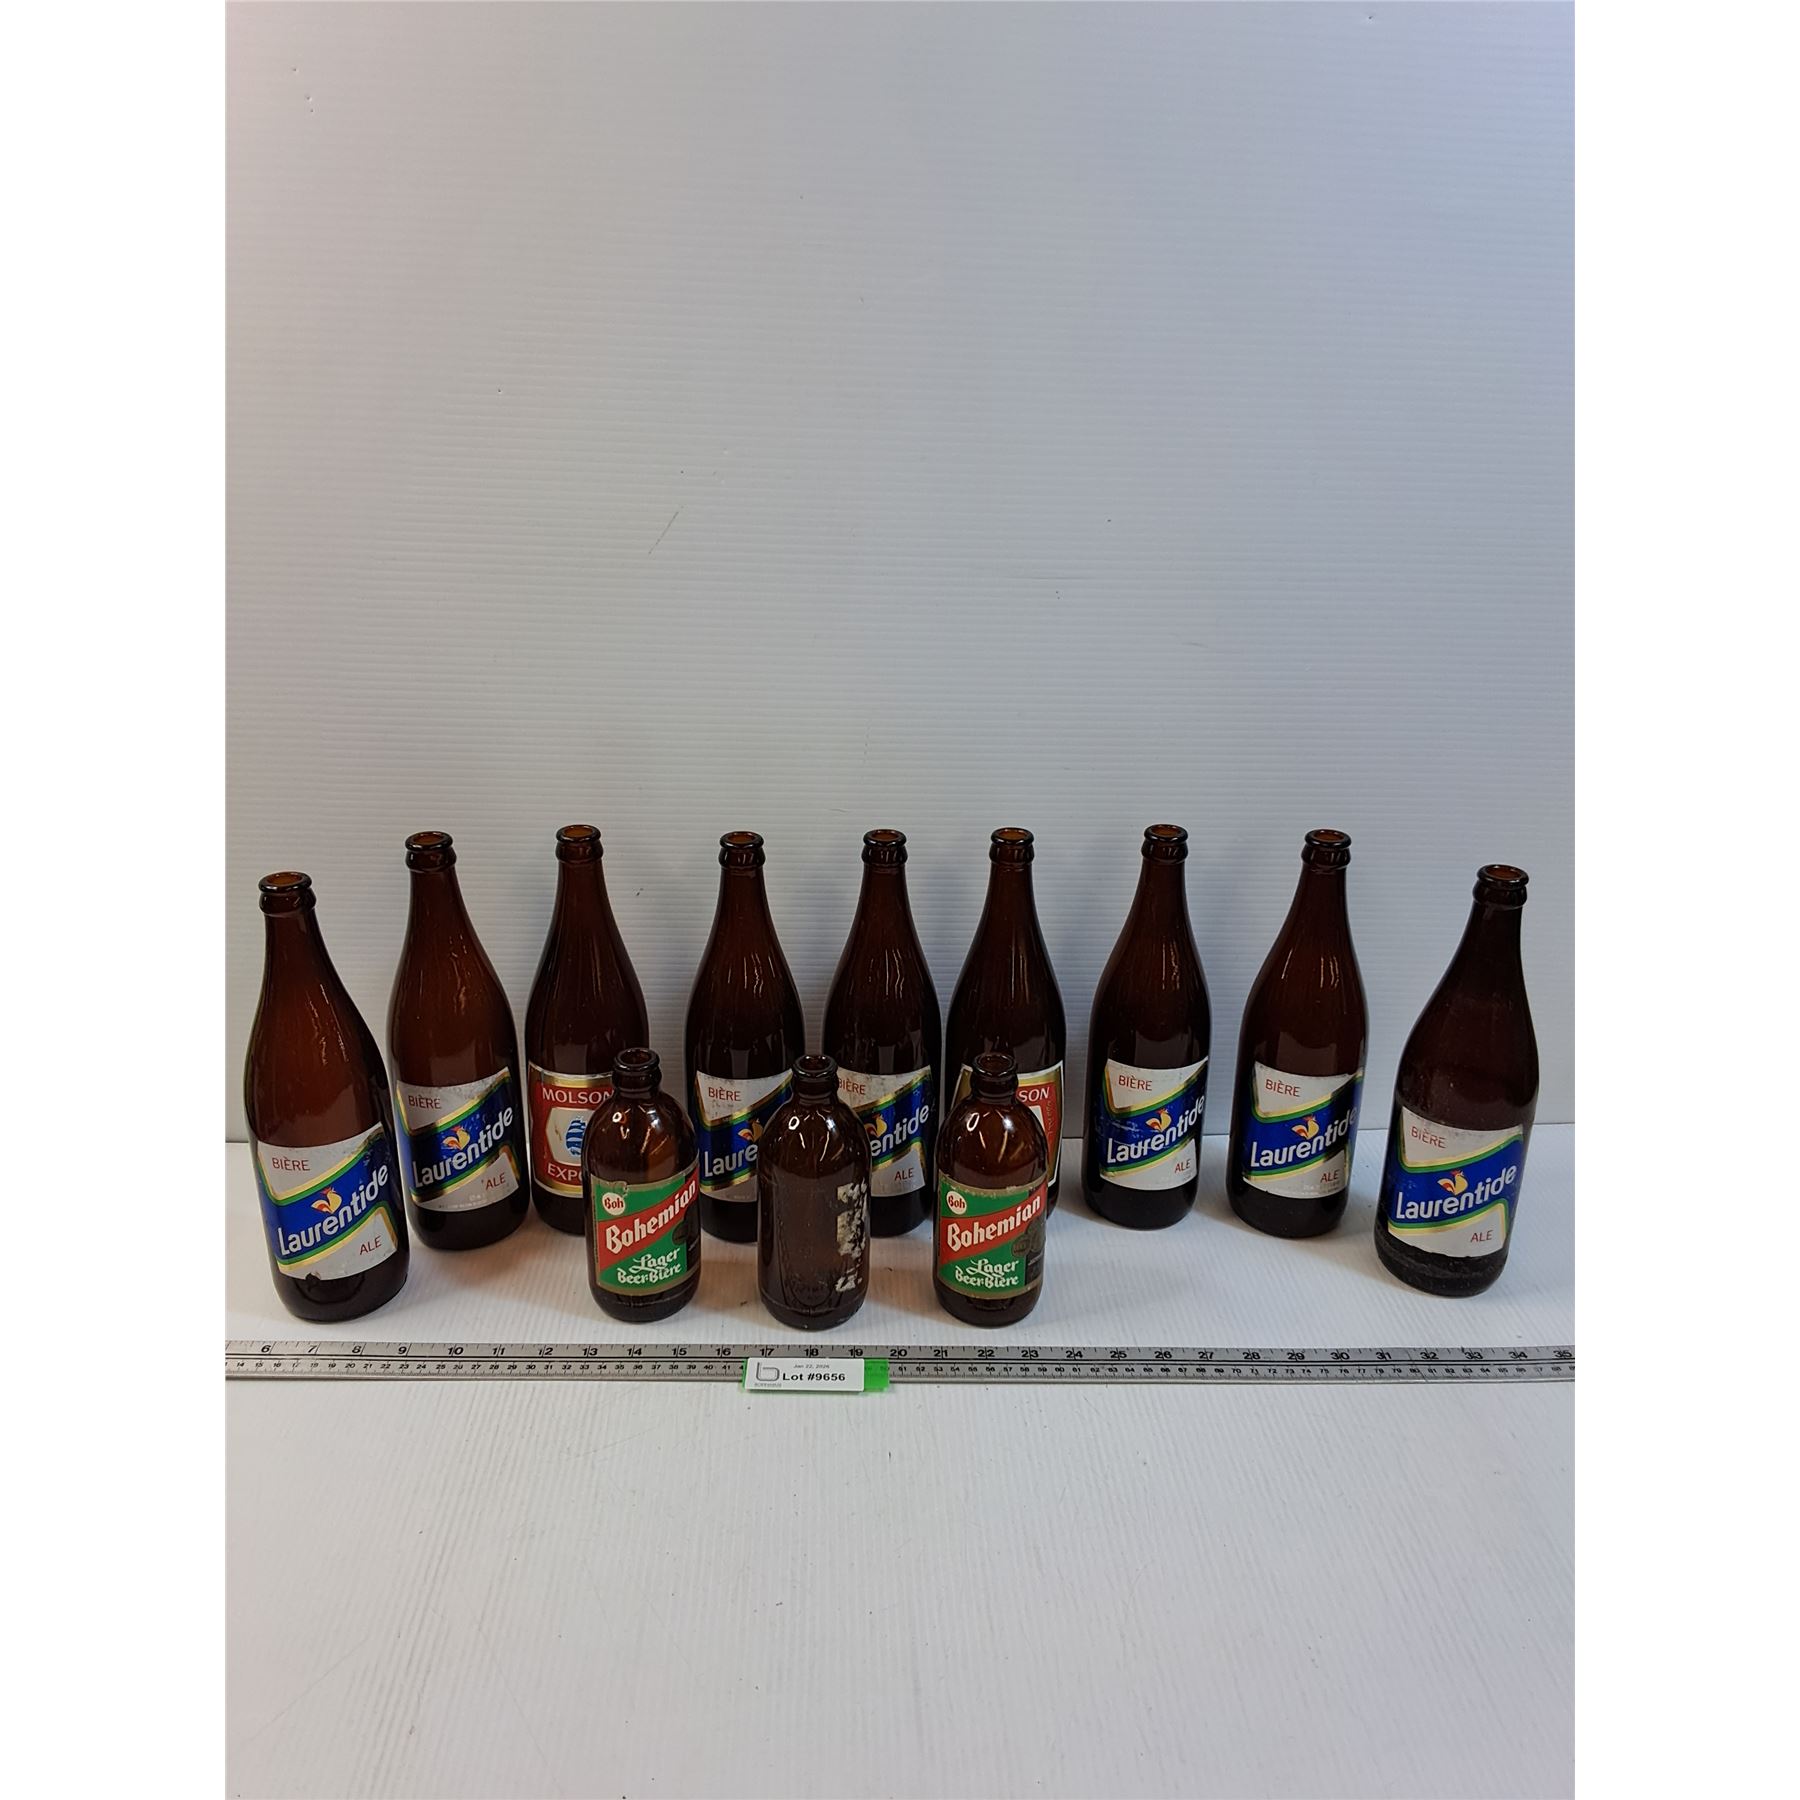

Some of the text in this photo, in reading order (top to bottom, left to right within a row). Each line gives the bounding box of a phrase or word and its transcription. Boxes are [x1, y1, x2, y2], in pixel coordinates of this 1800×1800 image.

[1118, 1074, 1152, 1091] BIÈRE
[1265, 1079, 1300, 1097] BIÈRE
[408, 1095, 442, 1110] BIÈRE
[709, 1087, 741, 1101] BIÈRE
[1018, 1086, 1050, 1102] SON
[871, 1104, 929, 1157] entide
[1107, 1096, 1205, 1163] Laurentide
[1250, 1106, 1357, 1167] Laurentide
[1411, 1126, 1446, 1148] BIÈRE
[413, 1106, 514, 1188] Laurentide
[272, 1157, 310, 1171] BIÈRE
[704, 1143, 758, 1177] Laure
[1174, 1160, 1191, 1173] ALE
[548, 1163, 582, 1181] EXP
[894, 1168, 914, 1181] ALE
[1320, 1169, 1339, 1183] ALE
[486, 1172, 506, 1191] ALE
[1396, 1165, 1517, 1219] Laurentide
[277, 1164, 389, 1256] Laurentide
[604, 1198, 623, 1209] Boh
[948, 1196, 965, 1208] Boh
[606, 1181, 695, 1254] Bohemian
[947, 1196, 1040, 1252] Bohemian
[1470, 1230, 1493, 1243] ALE
[359, 1236, 382, 1256] ALE
[629, 1247, 680, 1273] Lager
[966, 1259, 1019, 1277] Lager
[308, 1345, 317, 1353] 7
[448, 1347, 463, 1355] 10
[716, 1348, 731, 1356] 16
[1154, 1351, 1172, 1359] 26
[1287, 1352, 1305, 1360] 29
[1331, 1352, 1349, 1360] 30
[808, 1373, 845, 1381] #9656
